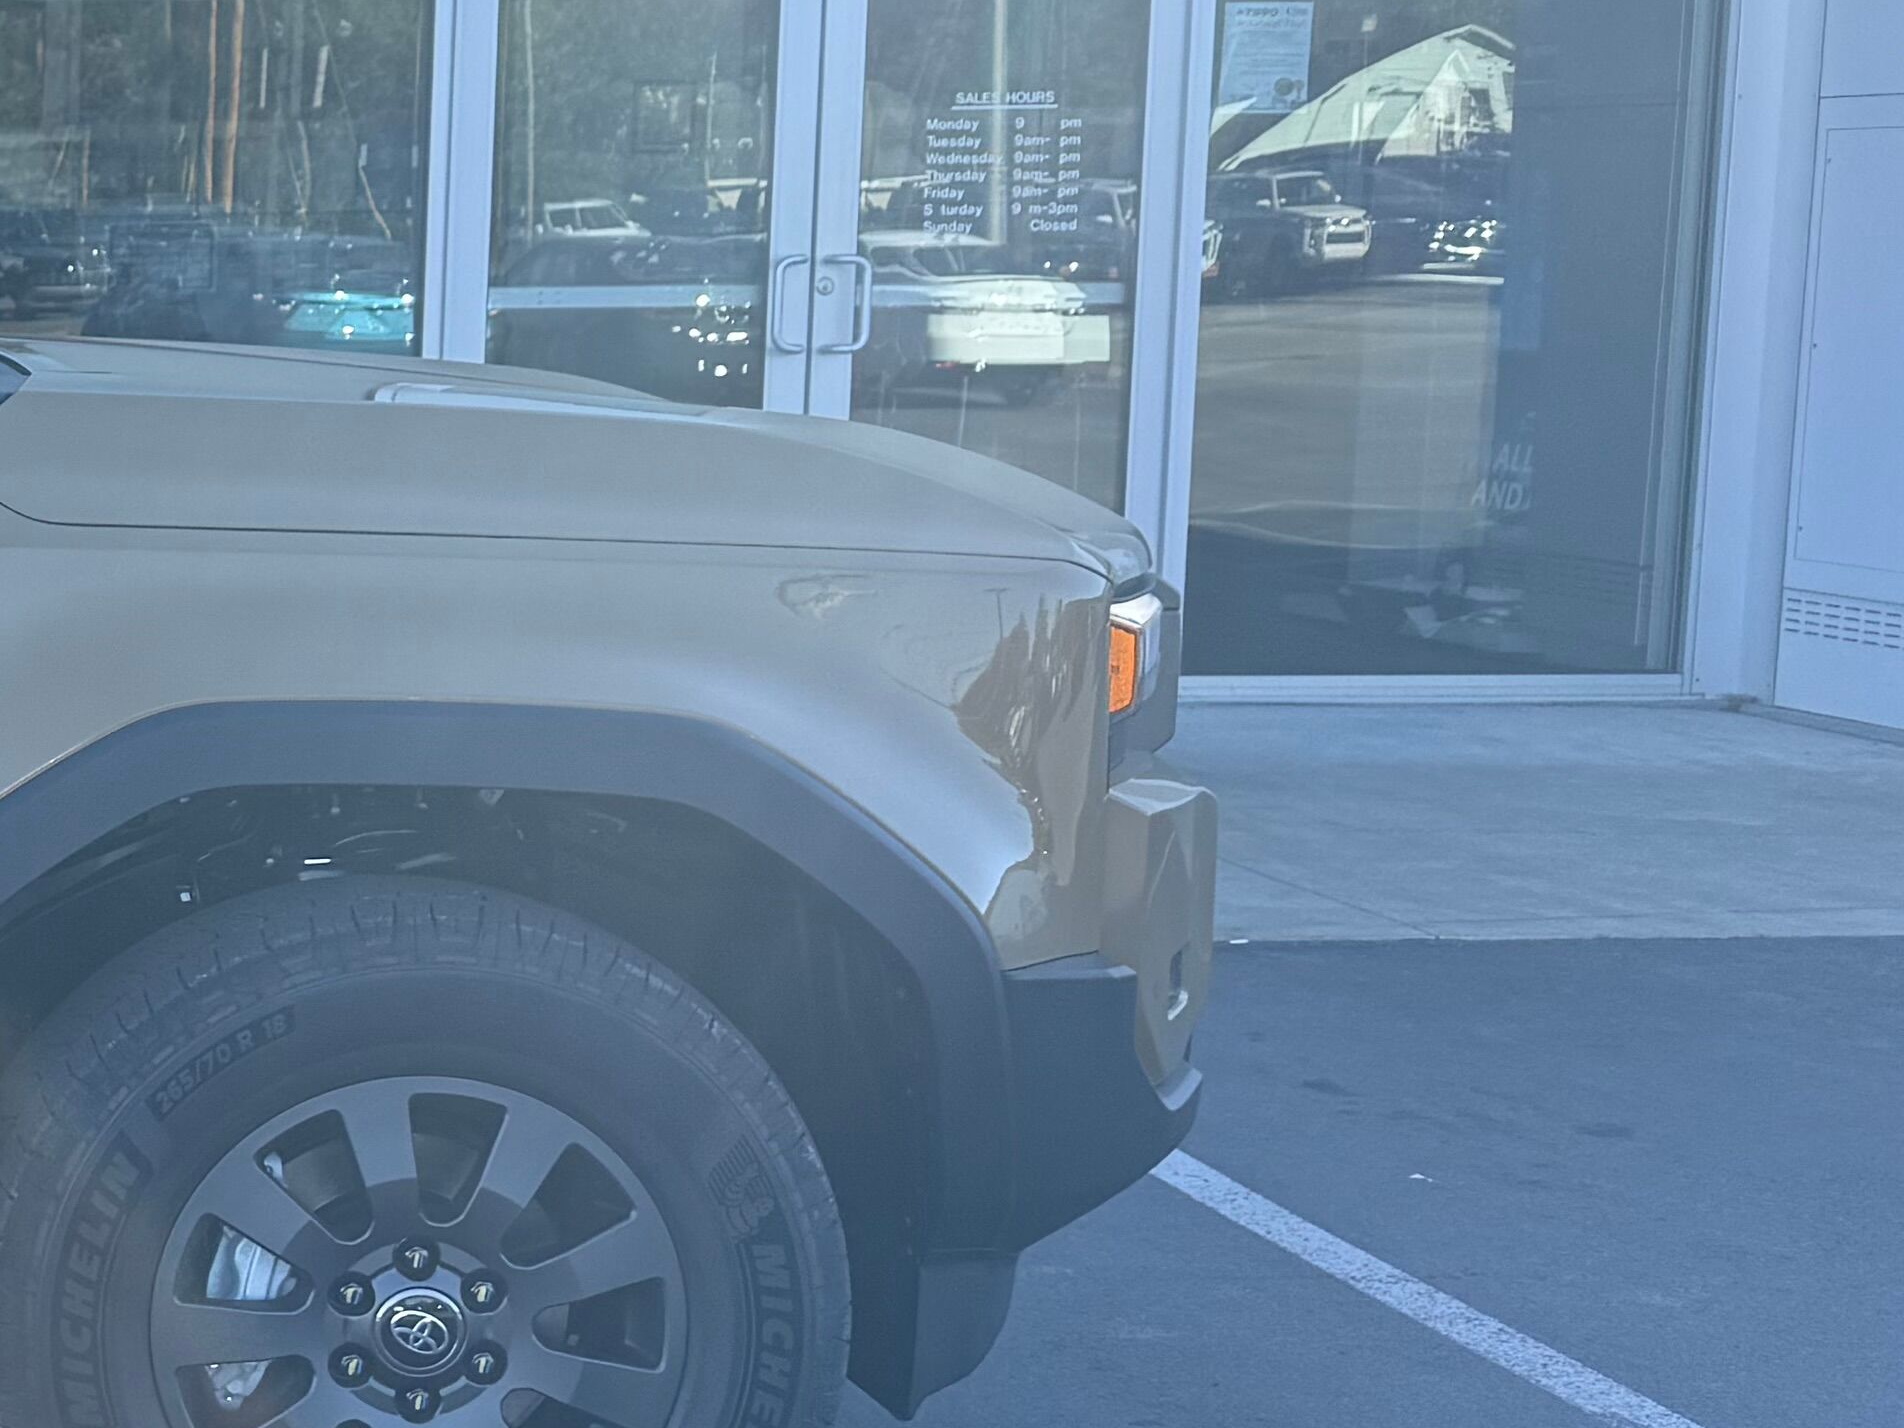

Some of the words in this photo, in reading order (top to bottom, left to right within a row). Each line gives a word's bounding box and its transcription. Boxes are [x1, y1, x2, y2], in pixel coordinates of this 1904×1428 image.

[955, 91, 1001, 104] SALES
[1007, 91, 1055, 104] HOURS
[926, 118, 979, 131] Monday
[927, 134, 981, 149] Tuesday
[926, 151, 1003, 166] Wednesday
[926, 168, 986, 183] Thursday
[923, 185, 964, 201] Friday
[923, 220, 972, 235] Sunday
[1030, 218, 1077, 232] Closed
[155, 1043, 232, 1115] 265/70
[237, 1028, 256, 1050] R
[261, 1013, 288, 1039] 18
[59, 1150, 141, 1428] MICHELIN
